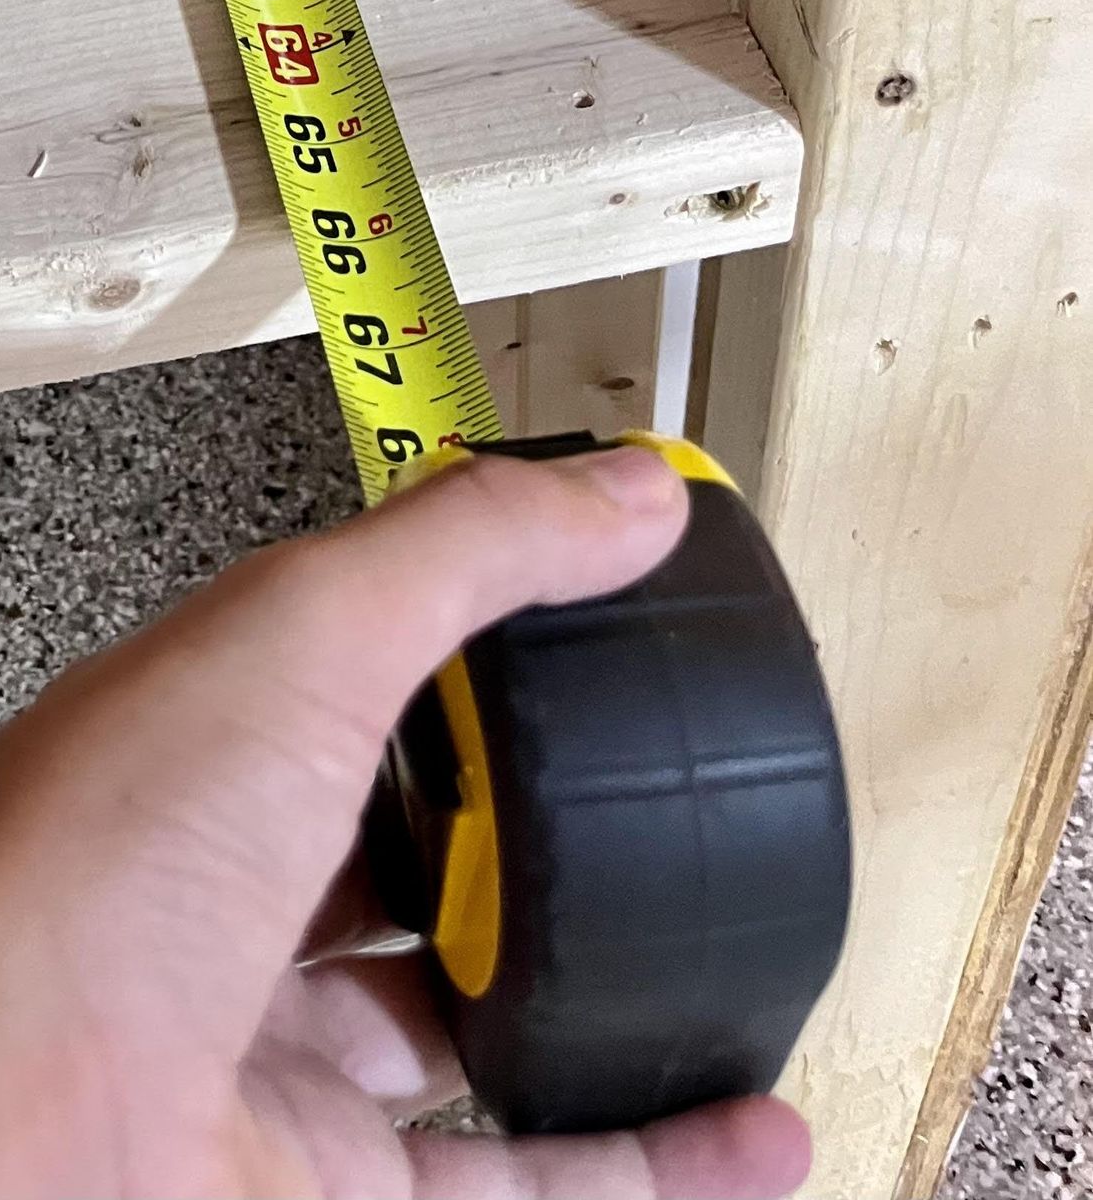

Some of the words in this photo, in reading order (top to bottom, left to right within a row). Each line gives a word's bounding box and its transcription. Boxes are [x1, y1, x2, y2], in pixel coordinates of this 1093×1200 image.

[264, 28, 313, 82] 64
[284, 113, 337, 174] 65
[311, 31, 334, 48] 4
[337, 117, 362, 137] 5
[367, 213, 393, 235] 6
[401, 316, 428, 336] 7
[311, 208, 367, 275] 66
[343, 313, 404, 386] 67
[376, 427, 424, 483] 6
